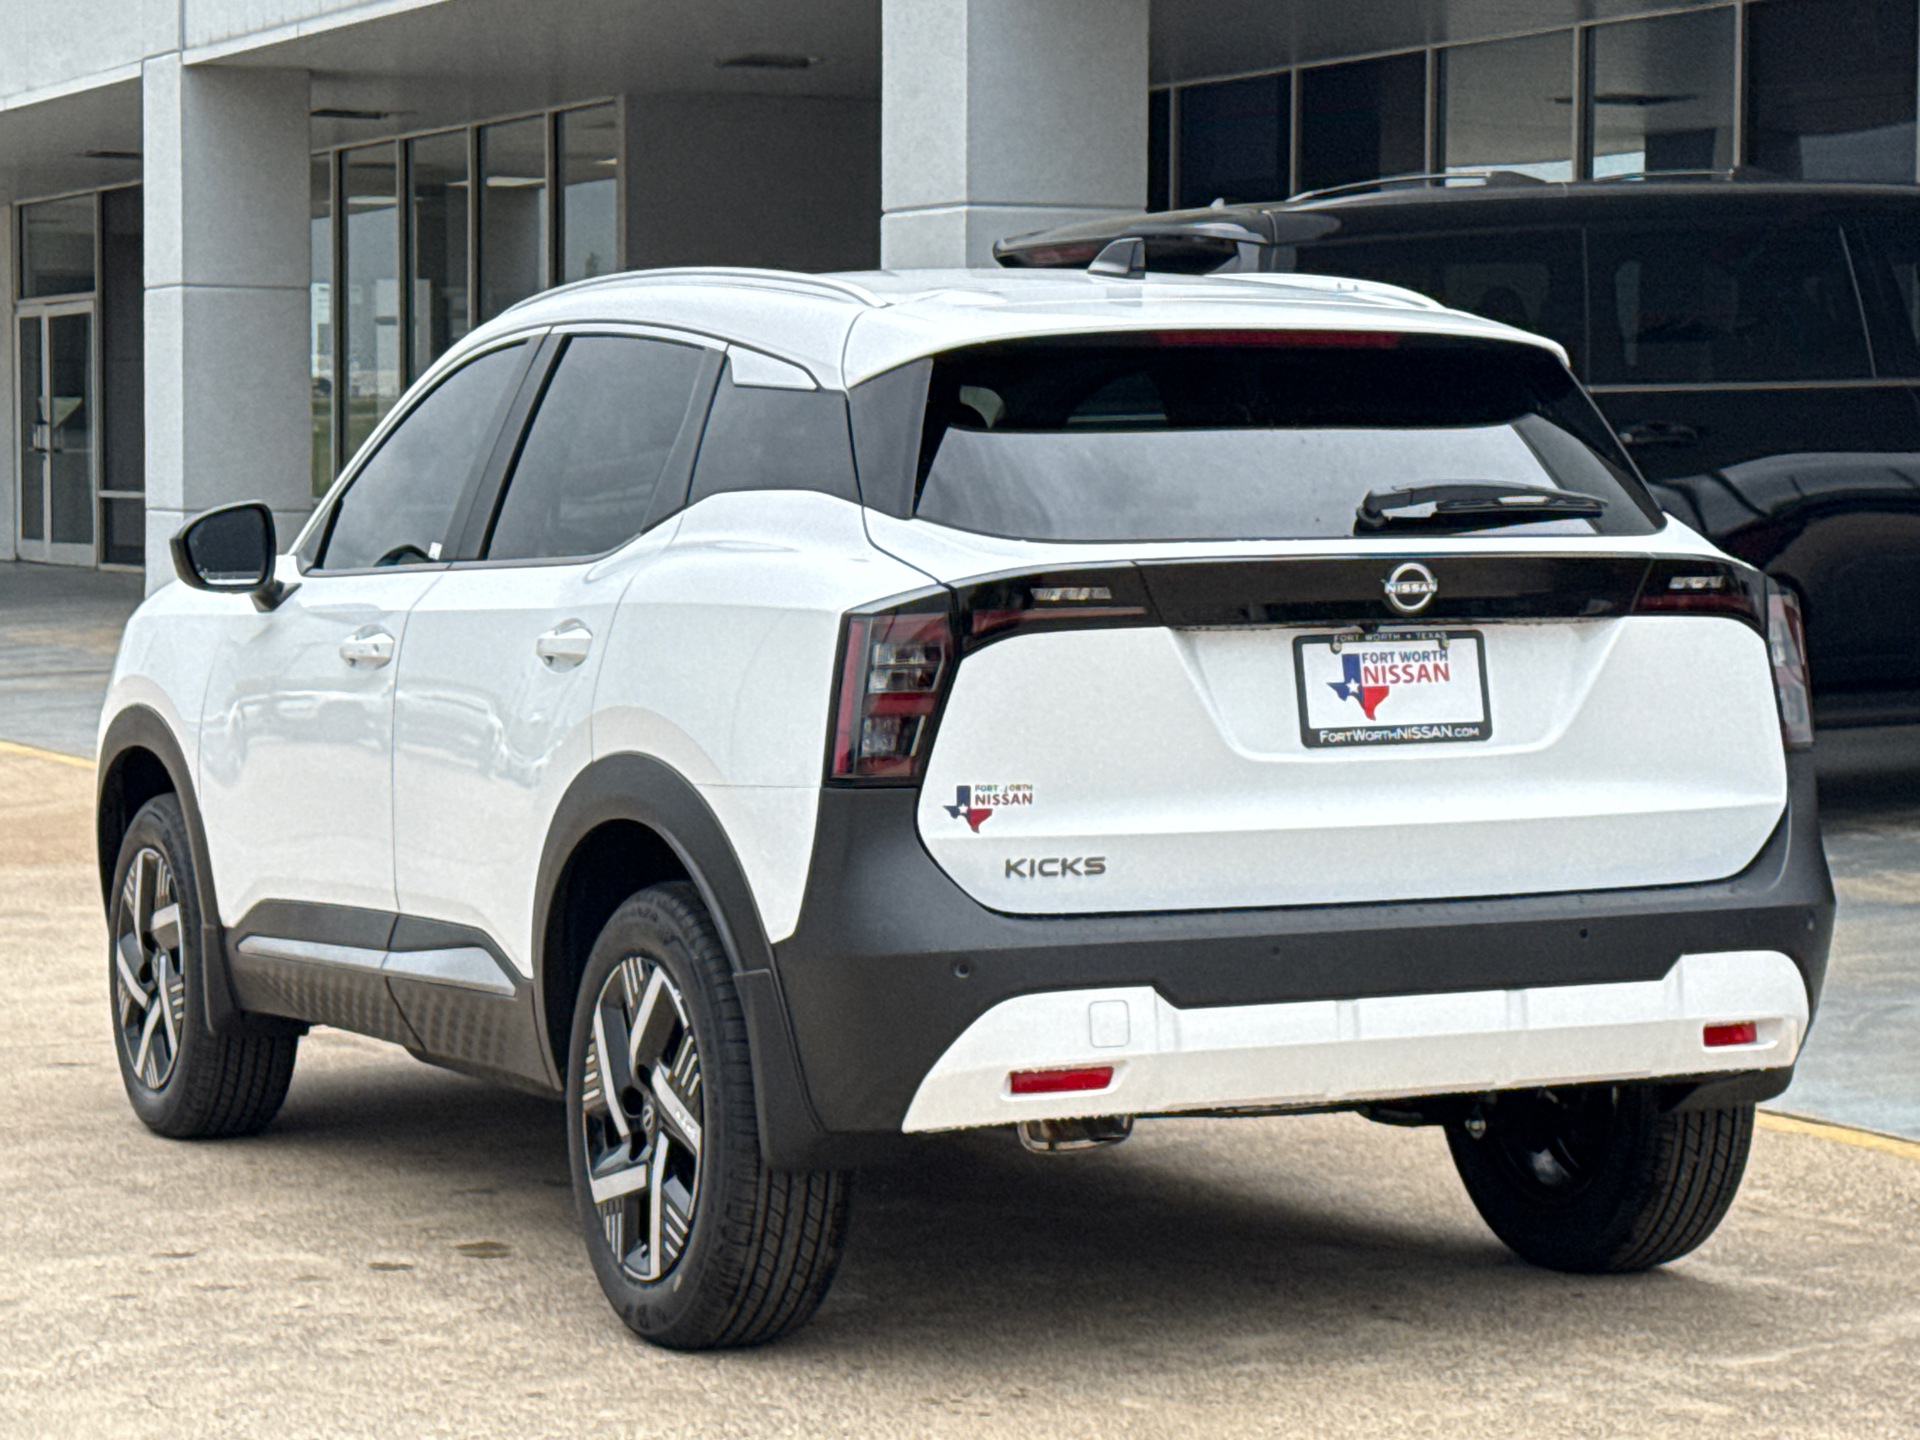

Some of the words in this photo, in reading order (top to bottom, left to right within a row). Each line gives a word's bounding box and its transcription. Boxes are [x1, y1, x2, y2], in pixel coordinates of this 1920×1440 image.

[1385, 582, 1438, 595] NISSAN
[1334, 634, 1359, 643] FORT
[1365, 632, 1400, 641] WORTH
[1416, 631, 1447, 640] TEXAS
[1361, 652, 1396, 664] FORT
[1399, 650, 1448, 663] WORTH
[1363, 663, 1450, 684] NISSAN
[975, 784, 998, 793] FORT
[975, 793, 1033, 806] NISSAN
[1005, 856, 1106, 879] KICKS
